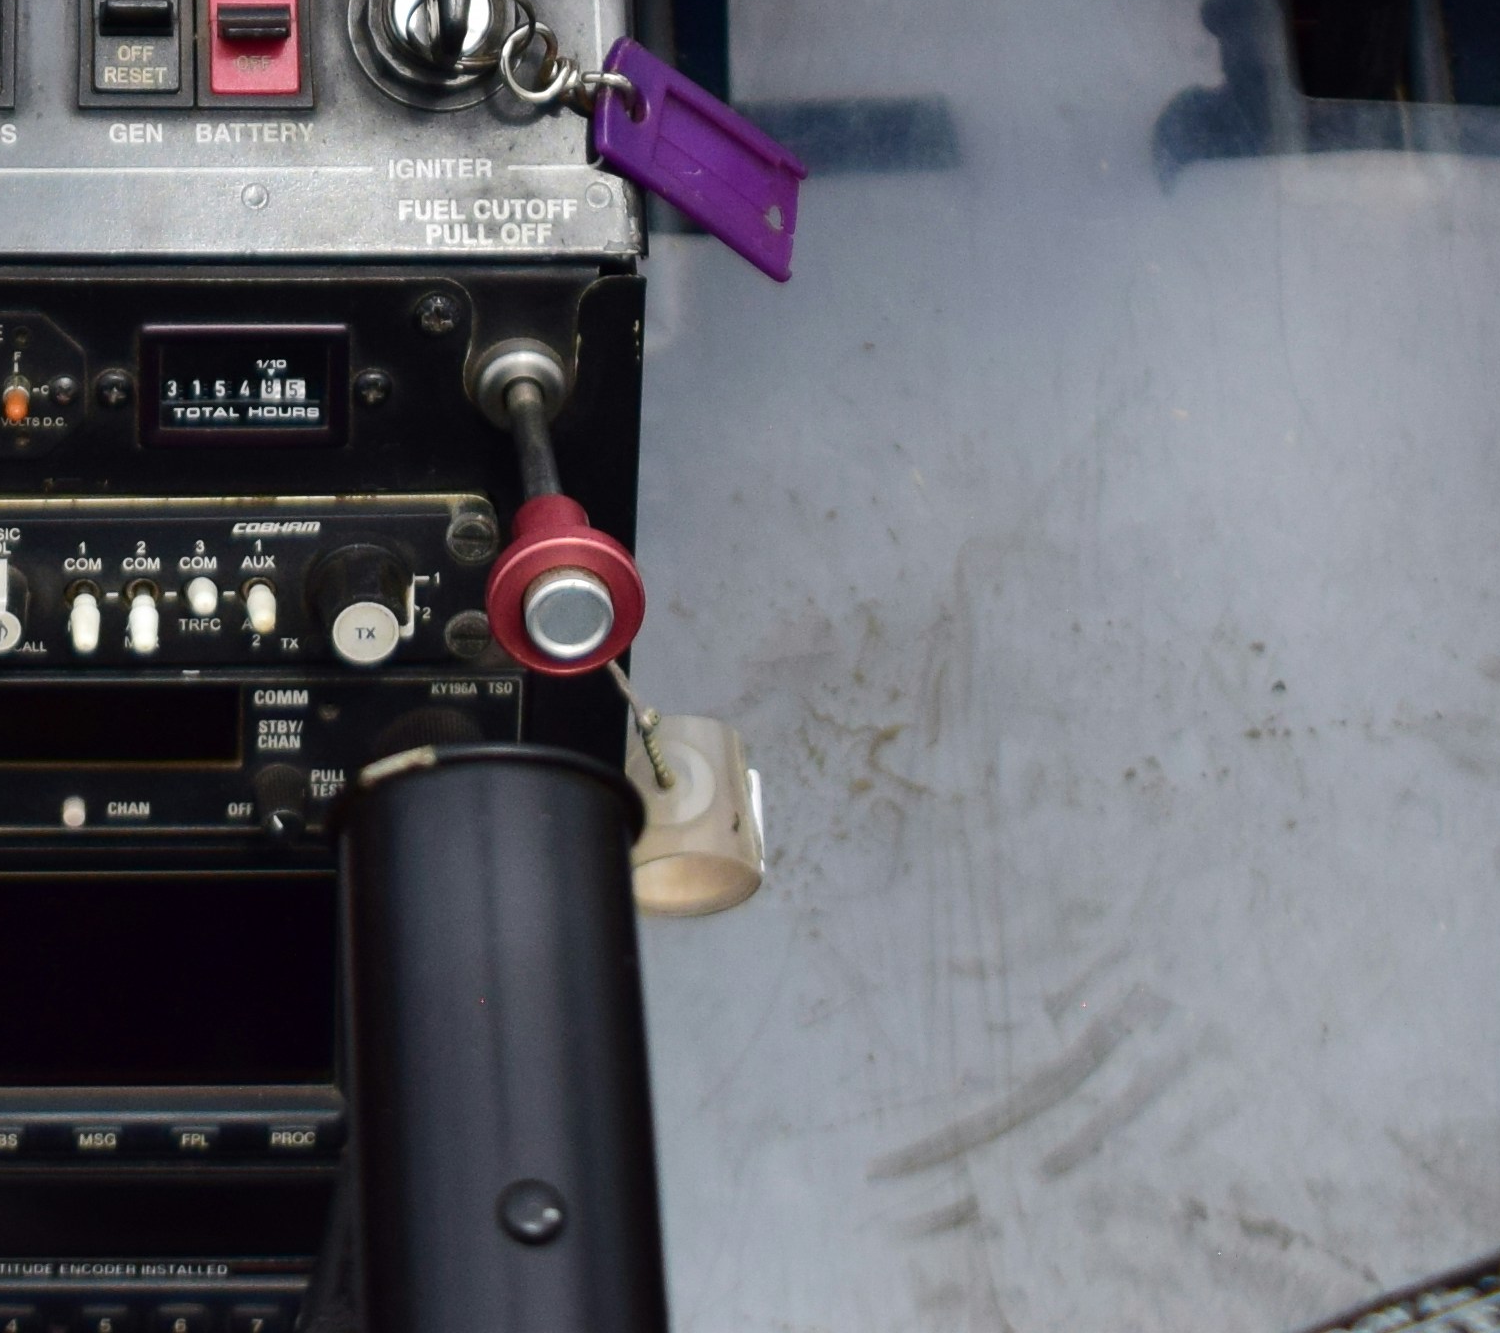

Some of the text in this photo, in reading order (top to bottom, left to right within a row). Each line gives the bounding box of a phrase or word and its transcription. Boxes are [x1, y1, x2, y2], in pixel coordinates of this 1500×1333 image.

[117, 45, 154, 61] OFF
[104, 67, 168, 84] RESET
[109, 123, 163, 144] GEN
[196, 122, 315, 143] BATTERY
[387, 158, 493, 180] IGNITER
[399, 198, 578, 221] FUEL CUTOFF
[426, 223, 553, 245] PULL OFF
[173, 405, 320, 420] TOTAL HOURS
[232, 520, 321, 535] COBHAM
[64, 557, 102, 572] COM
[122, 556, 161, 572] COM
[179, 555, 218, 571] COM
[241, 555, 276, 570] AUX
[178, 617, 222, 632] TRFC
[355, 626, 376, 641] TX
[280, 636, 300, 651] TX
[488, 681, 513, 694] TSO
[253, 690, 309, 706] COMM
[257, 719, 304, 735] STBY/
[257, 734, 301, 749] CHAN
[310, 769, 347, 784] PULL
[107, 801, 150, 817] CHAN
[227, 802, 255, 817] OFF
[78, 1133, 117, 1148] MSG
[180, 1133, 209, 1148] FPL
[270, 1131, 317, 1146] PROC
[59, 1262, 137, 1276] ENCODER
[141, 1262, 229, 1276] INSTALLED
